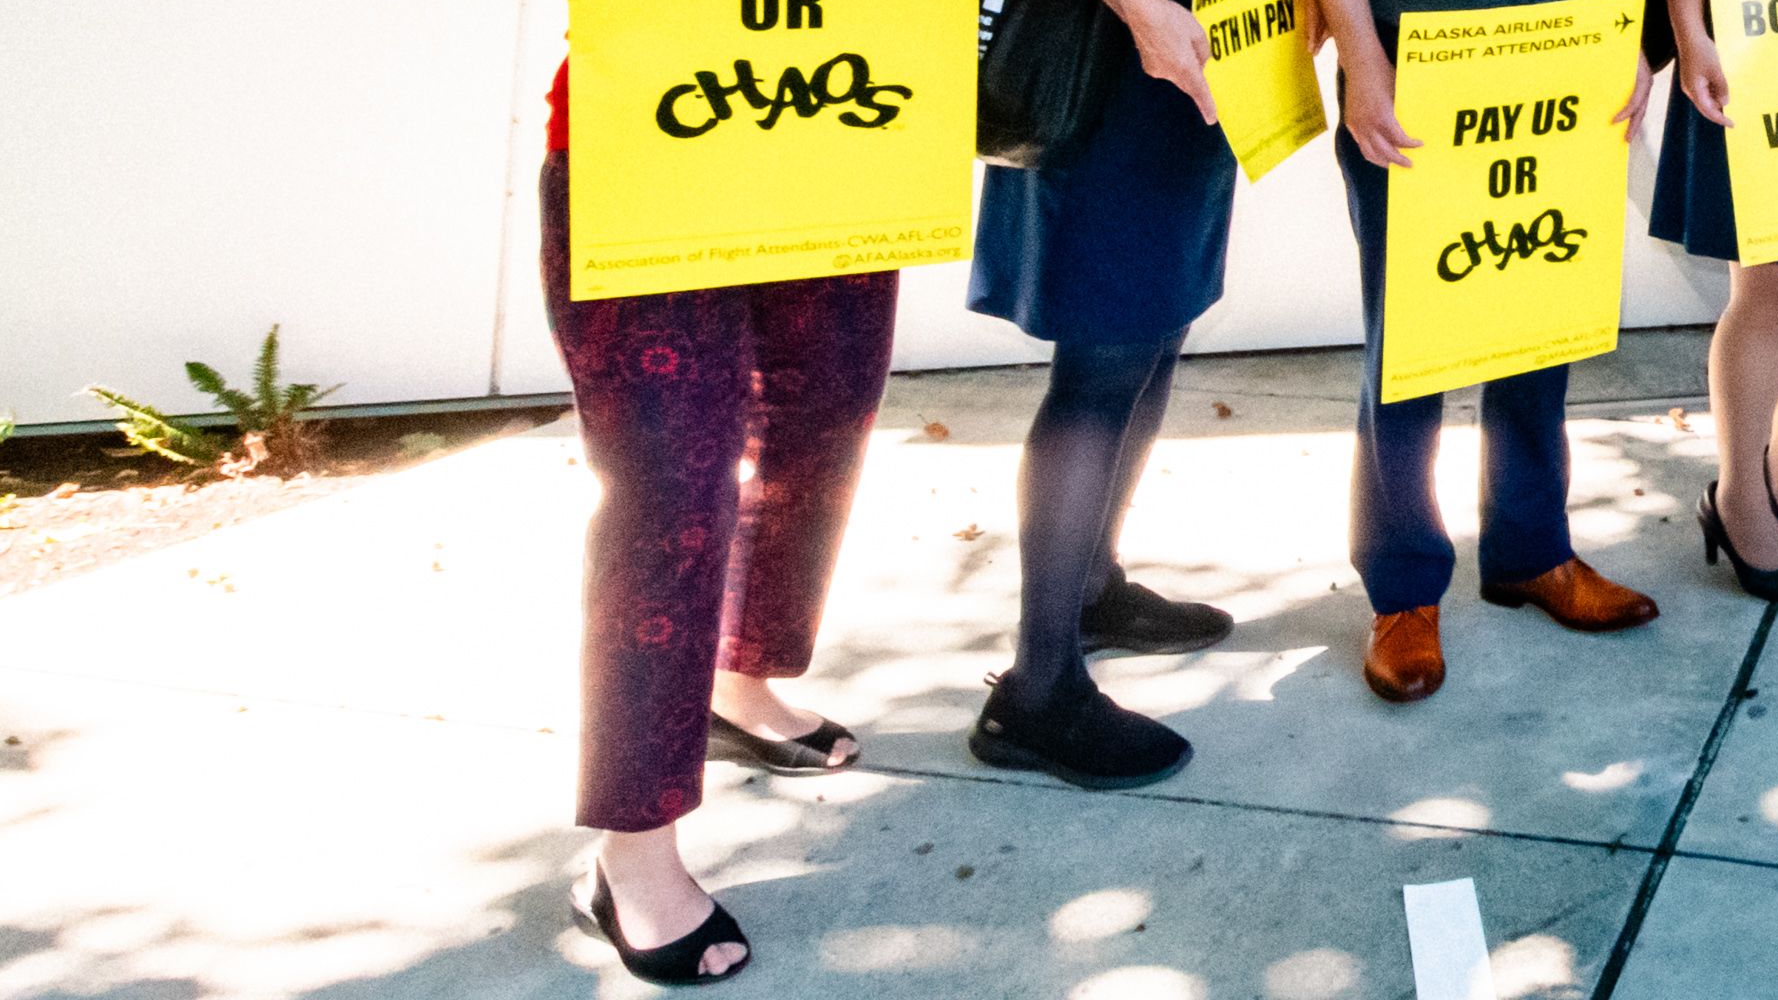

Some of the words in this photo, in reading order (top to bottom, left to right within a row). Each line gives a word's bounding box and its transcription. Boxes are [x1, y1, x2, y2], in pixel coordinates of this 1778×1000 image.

[1210, 15, 1241, 61] 6TH
[1242, 8, 1262, 47] IN
[1406, 48, 1476, 63] FLIGHT
[1482, 33, 1602, 57] ATTENDANTS
[1407, 26, 1487, 41] ALASKA
[1493, 16, 1574, 36] AIRLINES
[656, 53, 913, 138] CHAOS
[1453, 103, 1524, 147] PAY
[1531, 95, 1579, 136] US
[1488, 156, 1537, 199] OR
[585, 254, 680, 271] Association
[687, 249, 703, 262] of
[709, 245, 752, 262] Flight
[1436, 209, 1588, 283] CHAOS
